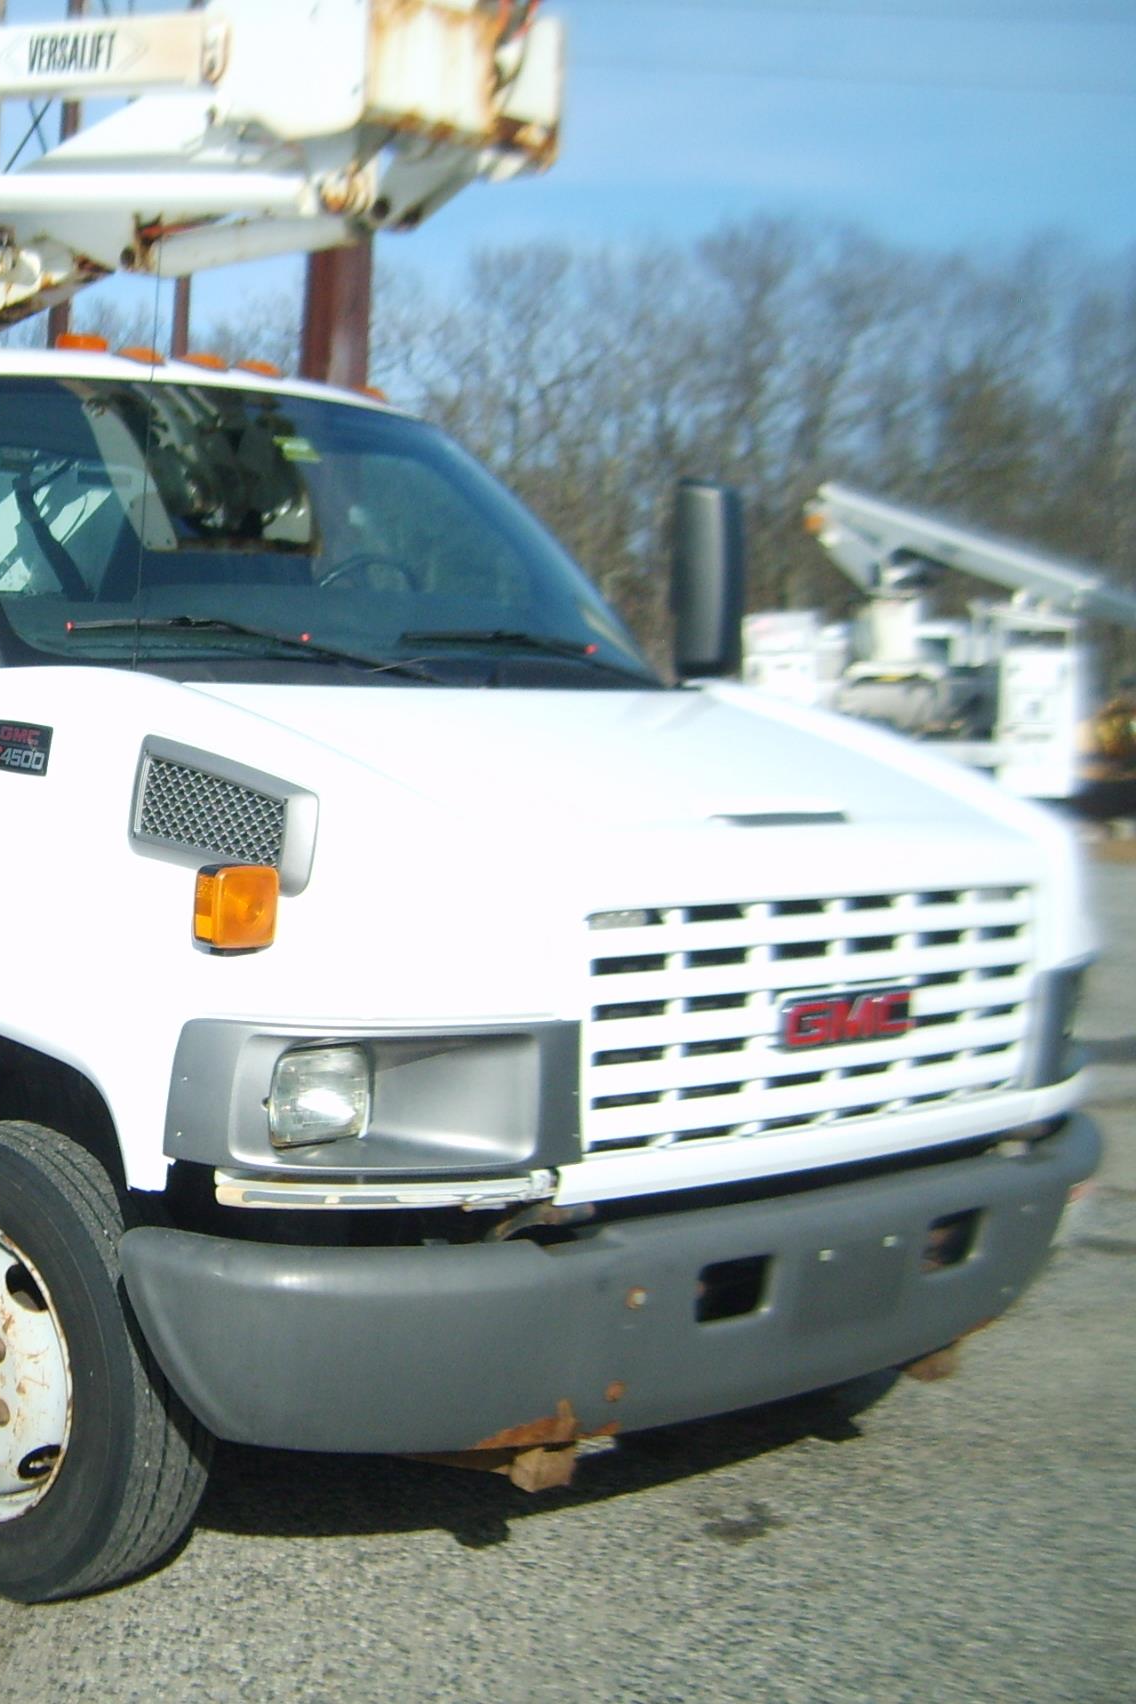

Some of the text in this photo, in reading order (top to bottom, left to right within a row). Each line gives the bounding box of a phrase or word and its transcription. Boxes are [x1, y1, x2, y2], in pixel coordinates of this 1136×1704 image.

[28, 29, 116, 73] VERSALIFT
[0, 726, 41, 745] GMC
[783, 990, 915, 1047] GMC
